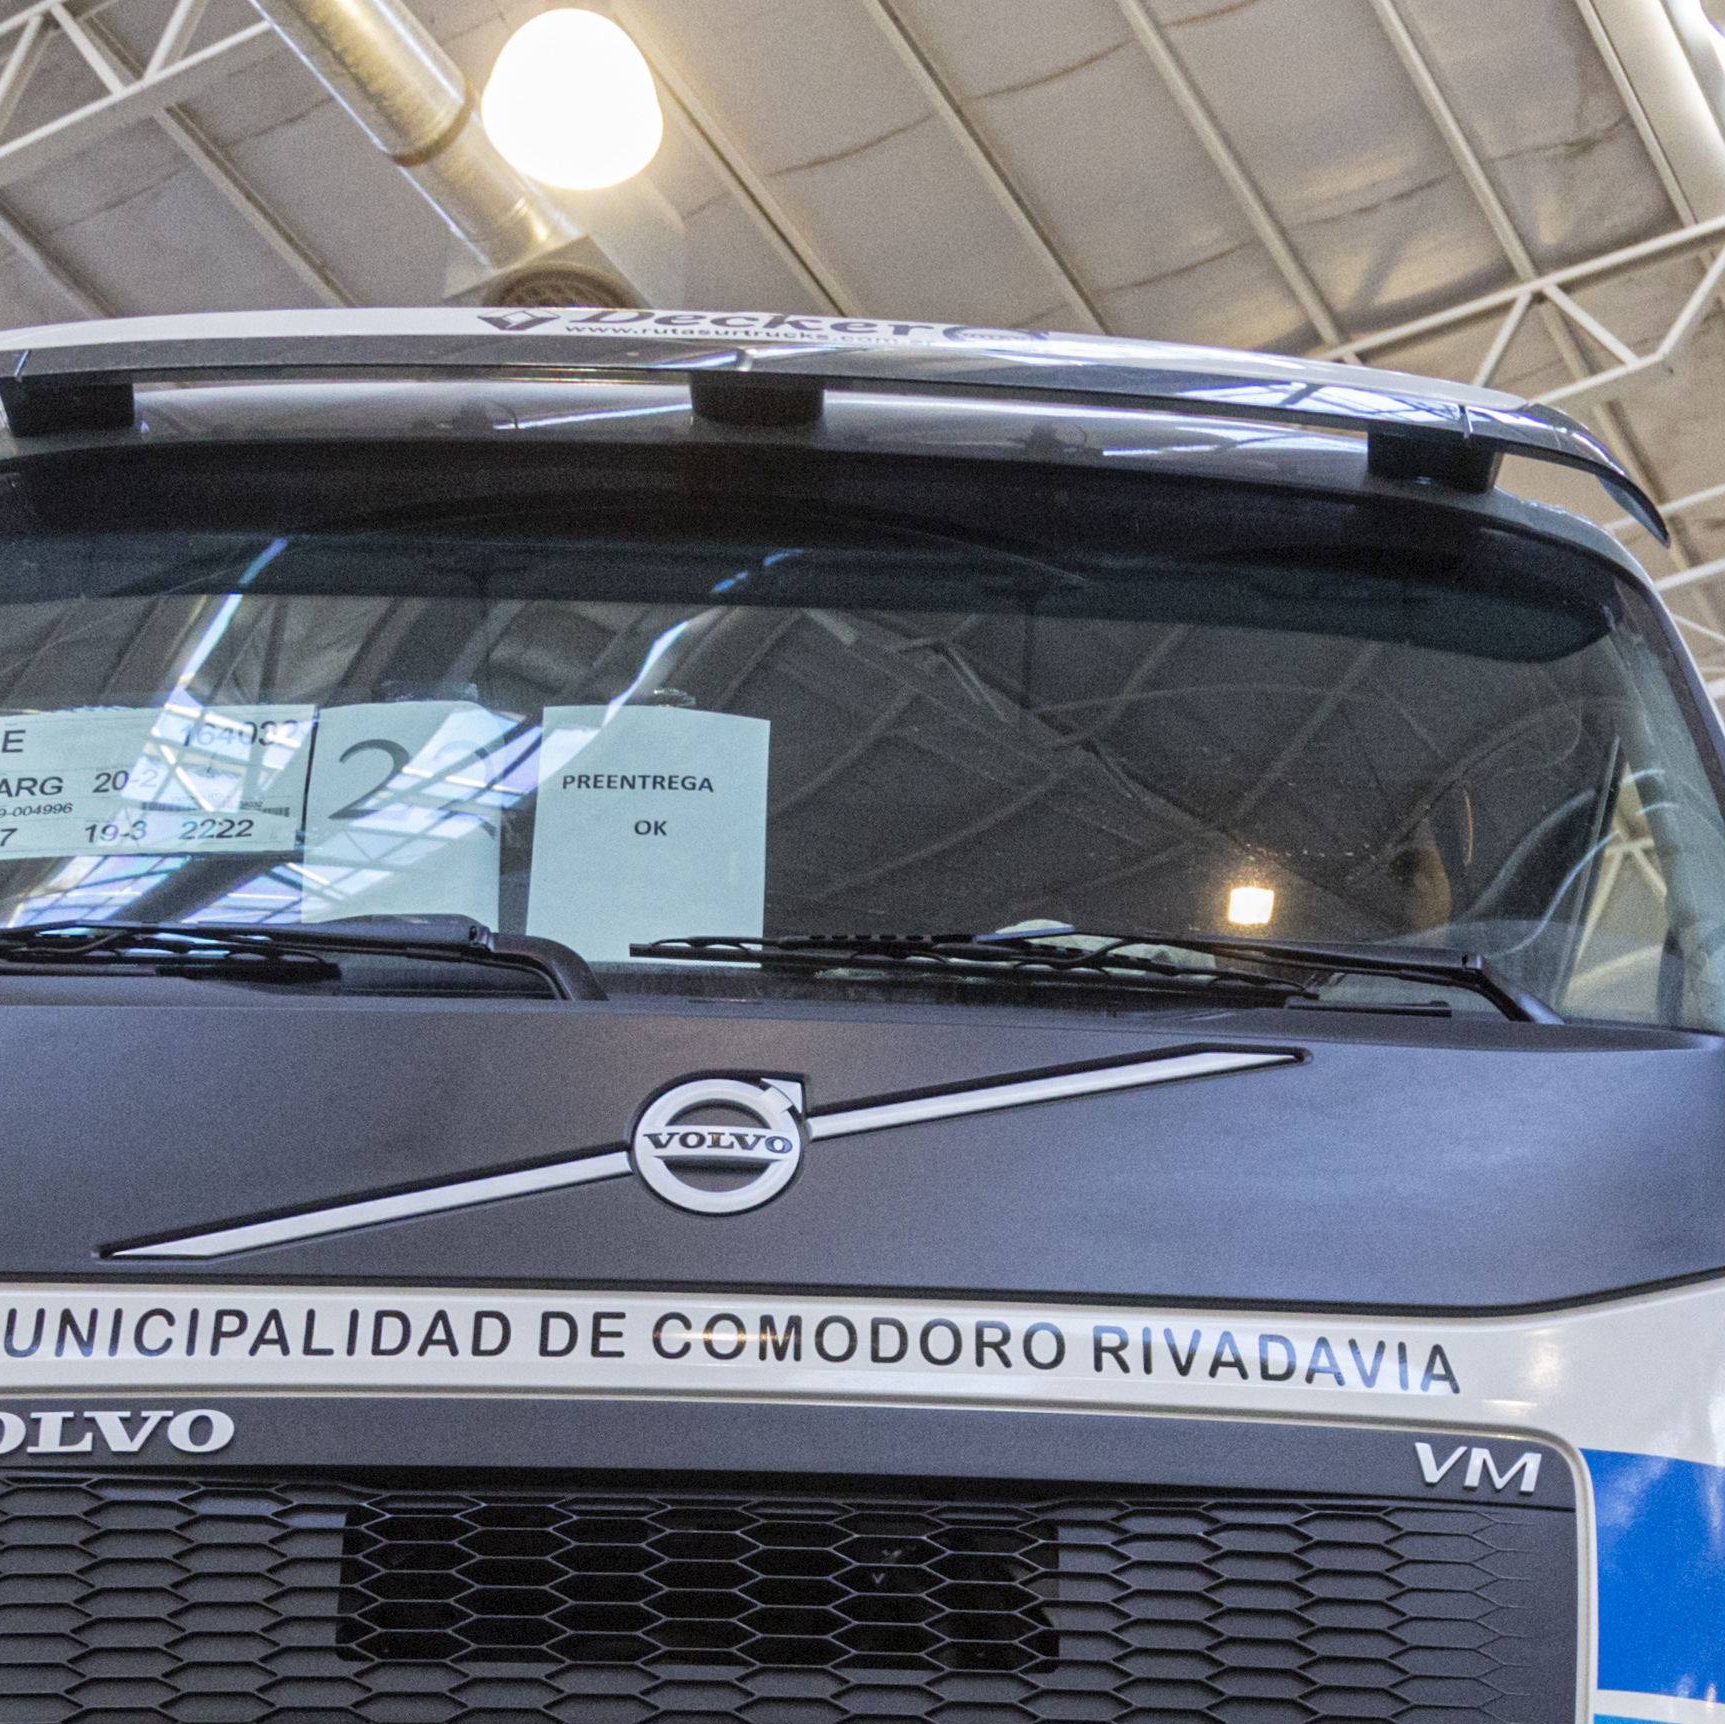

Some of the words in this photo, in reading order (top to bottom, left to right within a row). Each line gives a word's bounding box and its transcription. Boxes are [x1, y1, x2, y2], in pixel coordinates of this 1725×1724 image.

[569, 311, 934, 336] Decker
[1, 729, 27, 753] E
[562, 774, 714, 794] PREENTREGA
[84, 820, 149, 844] 19-3
[178, 818, 255, 841] 2222
[633, 819, 668, 837] OK
[643, 1131, 793, 1154] VOLVO
[538, 1311, 626, 1359] DE
[652, 1312, 1067, 1372] COMODORO
[1092, 1324, 1461, 1395] RIVADAVIA
[1413, 1441, 1543, 1494] VM
